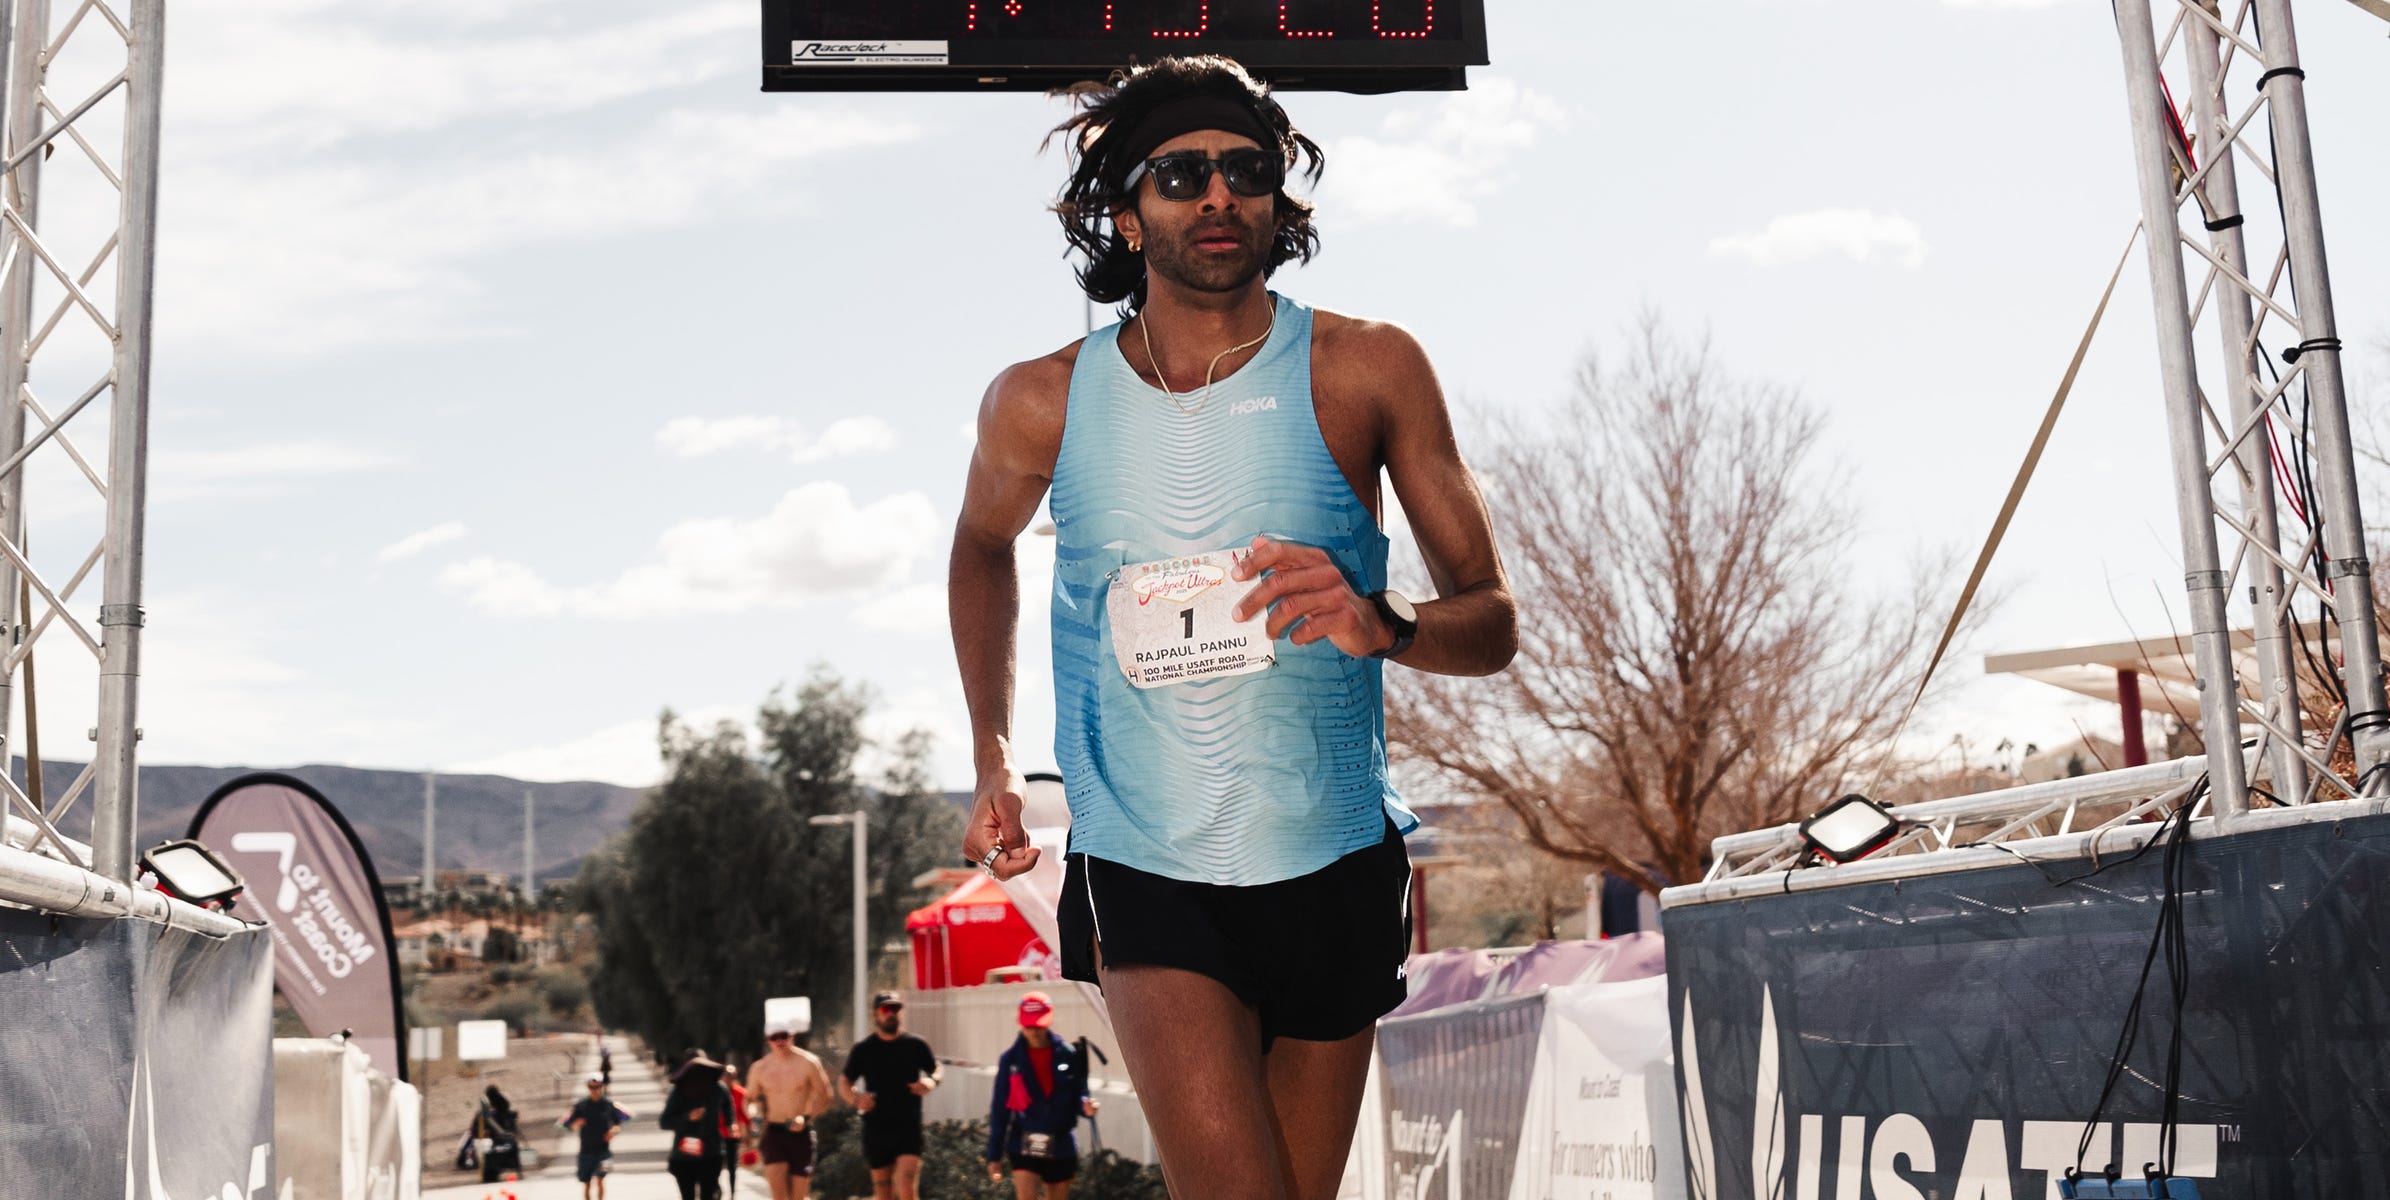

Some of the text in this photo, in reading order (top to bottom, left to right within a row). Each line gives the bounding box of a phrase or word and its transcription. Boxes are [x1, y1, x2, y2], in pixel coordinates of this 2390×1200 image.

[796, 43, 887, 57] Raceclock
[1229, 396, 1277, 416] HOKA
[1141, 556, 1211, 574] WELCOME
[1187, 573, 1223, 589] Ultras
[1180, 607, 1194, 639] 1
[1135, 636, 1247, 663] RAJPAUL PANNU
[1143, 667, 1160, 676] 100
[1162, 663, 1184, 673] MILE
[1187, 658, 1216, 669] USATF
[1218, 654, 1246, 664] ROAD
[1145, 661, 1247, 683] NATIONAL CHAMPIONSHIP
[1619, 1129, 1656, 1183] who
[1796, 1113, 2240, 1200] USAT TM
